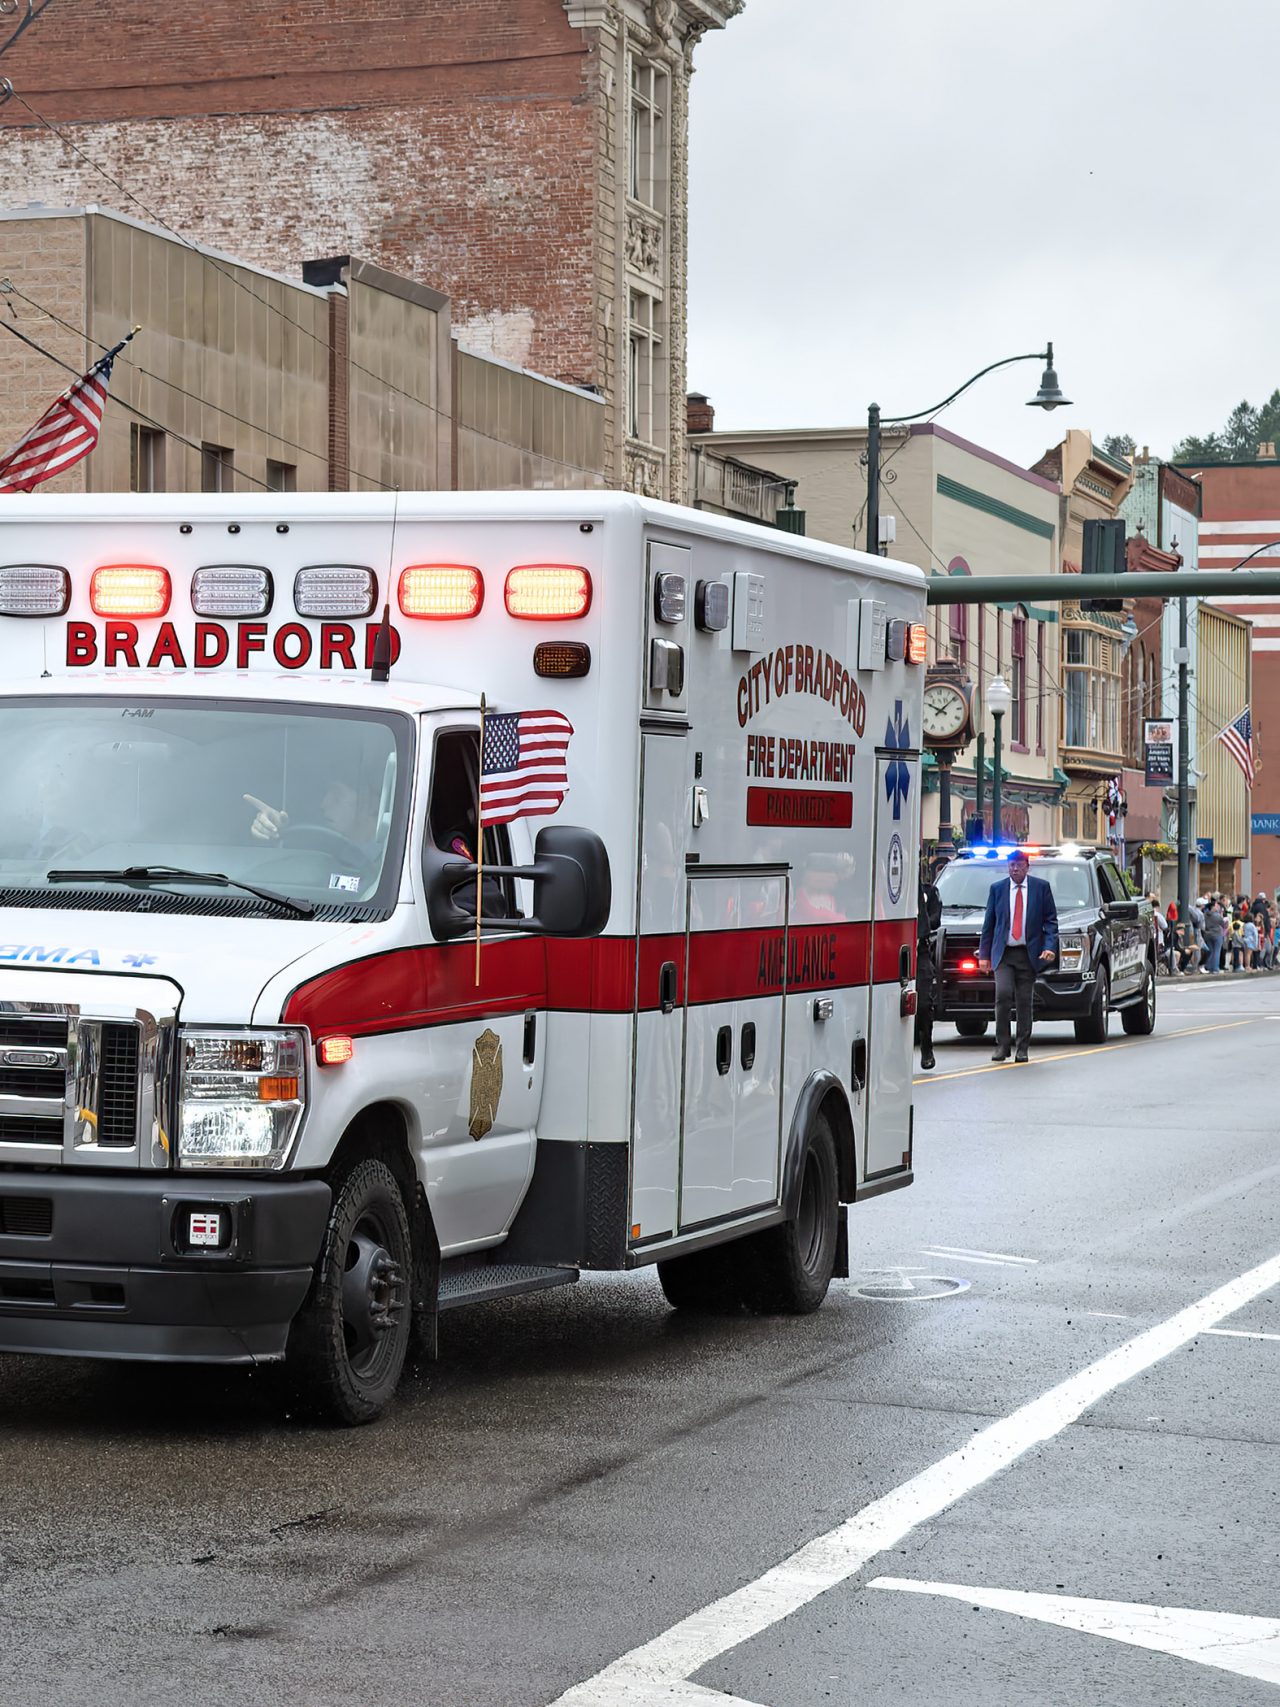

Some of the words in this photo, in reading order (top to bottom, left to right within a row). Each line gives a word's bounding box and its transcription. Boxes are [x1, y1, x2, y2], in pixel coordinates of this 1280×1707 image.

[66, 620, 402, 670] BRADFORD
[737, 651, 774, 729] CITY
[774, 644, 794, 698] OF
[795, 644, 866, 739] BRADFORD
[746, 734, 776, 779] FIRE
[778, 737, 856, 783] DEPARTMENT
[767, 793, 836, 822] PARAMEDIC
